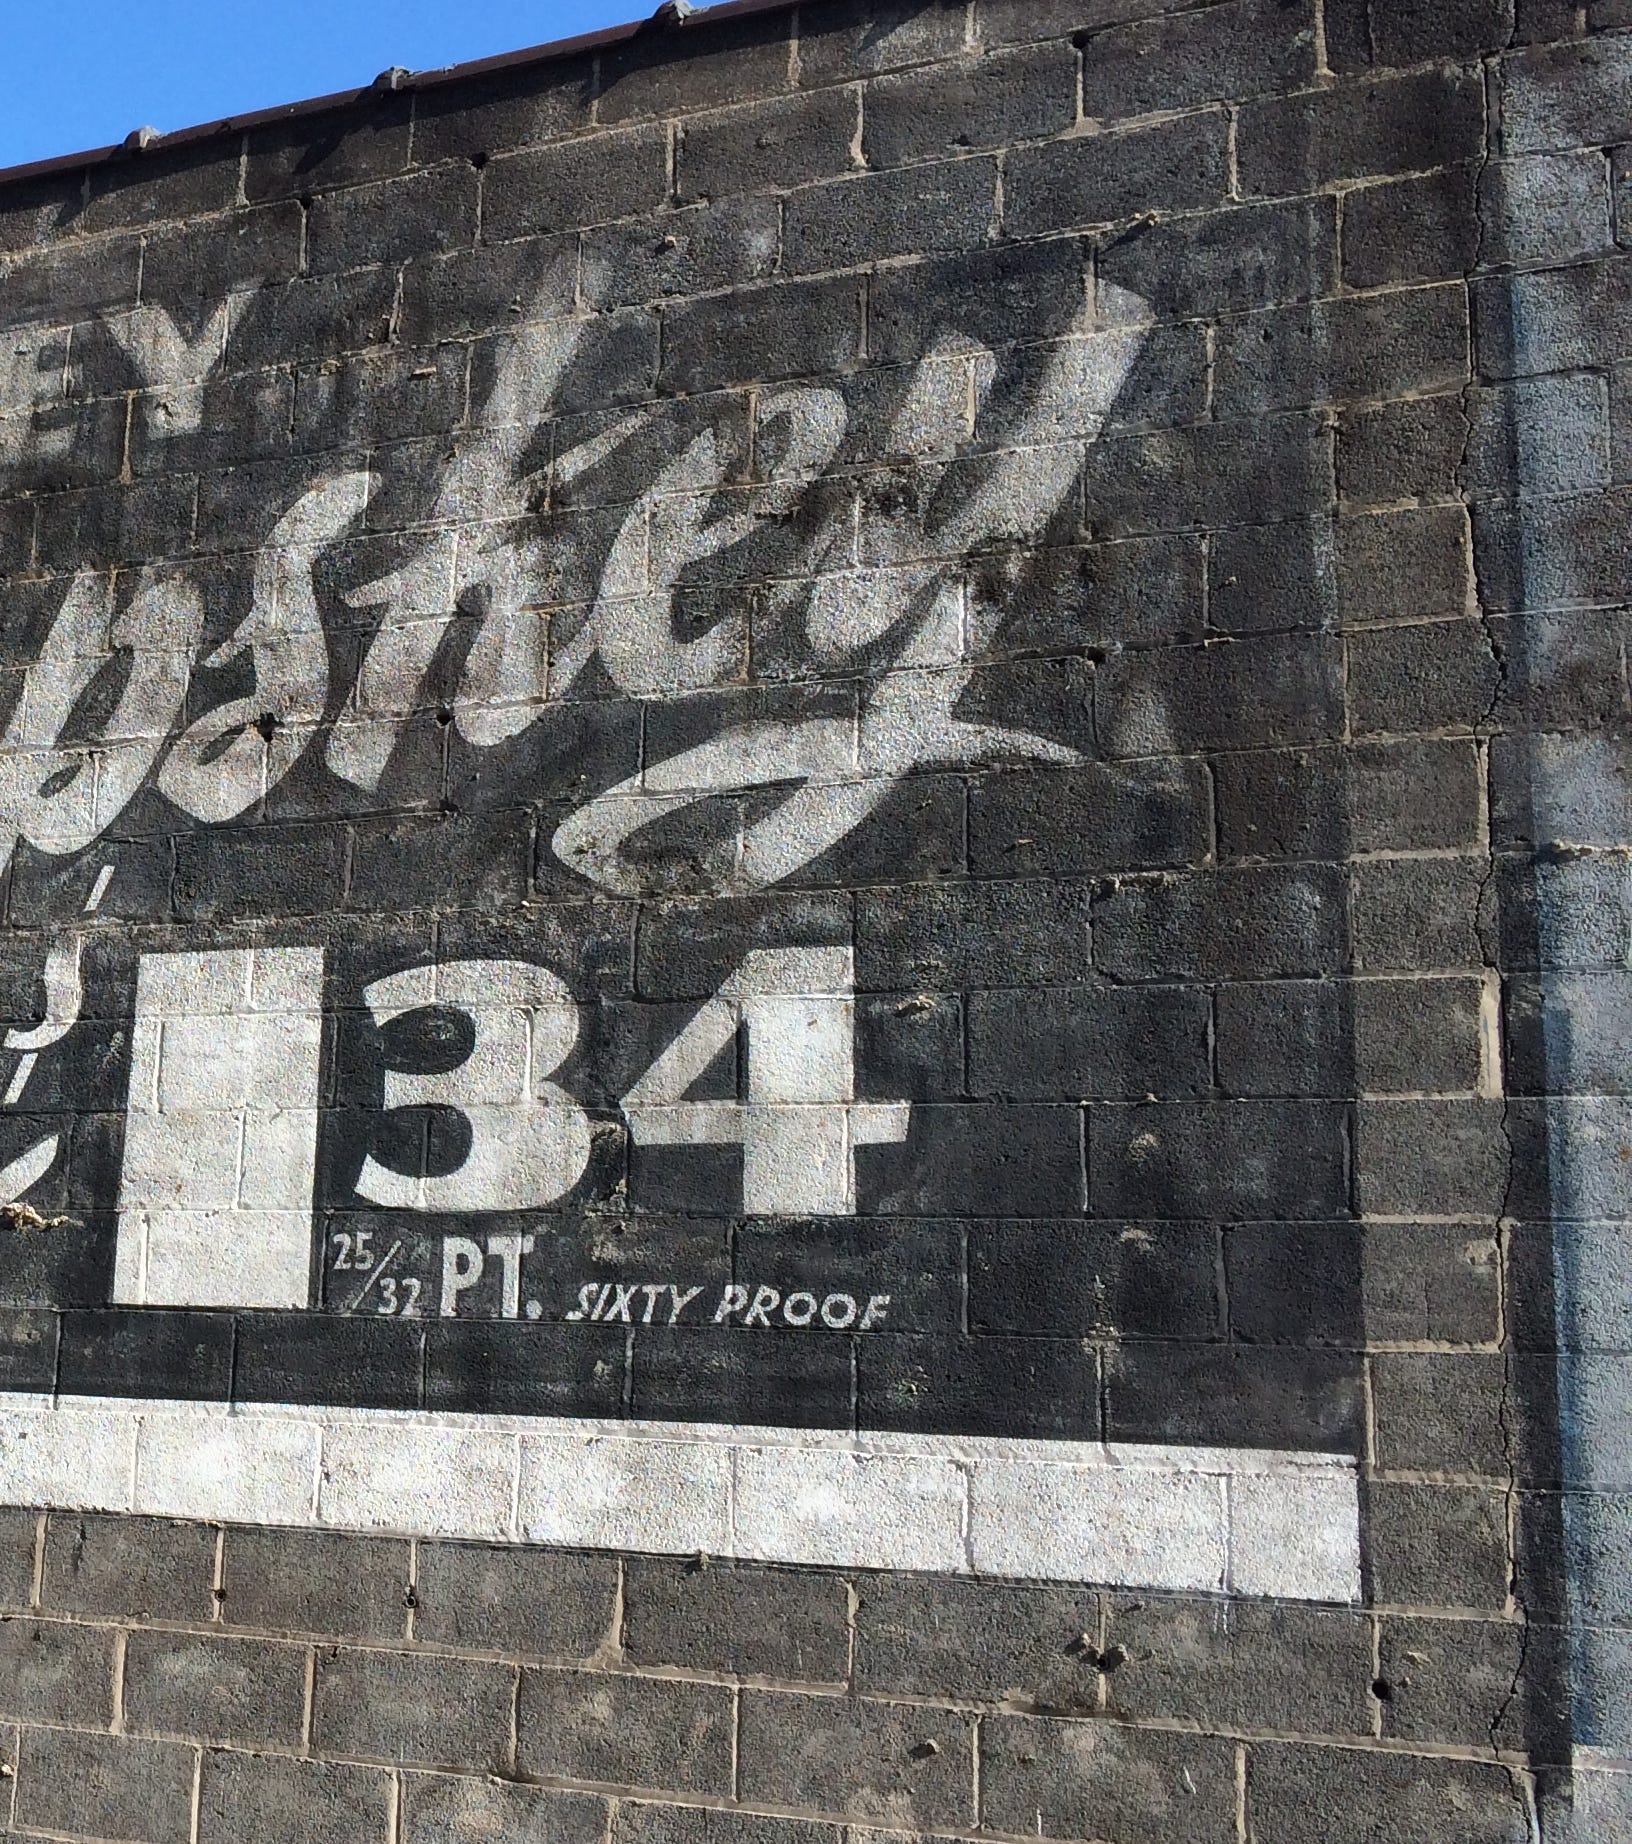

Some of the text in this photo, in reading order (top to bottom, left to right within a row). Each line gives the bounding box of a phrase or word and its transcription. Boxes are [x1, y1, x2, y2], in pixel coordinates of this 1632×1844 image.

[439, 1234, 544, 1320] PT.
[564, 1283, 705, 1327] SIXTY
[713, 1285, 893, 1331] PROOF
